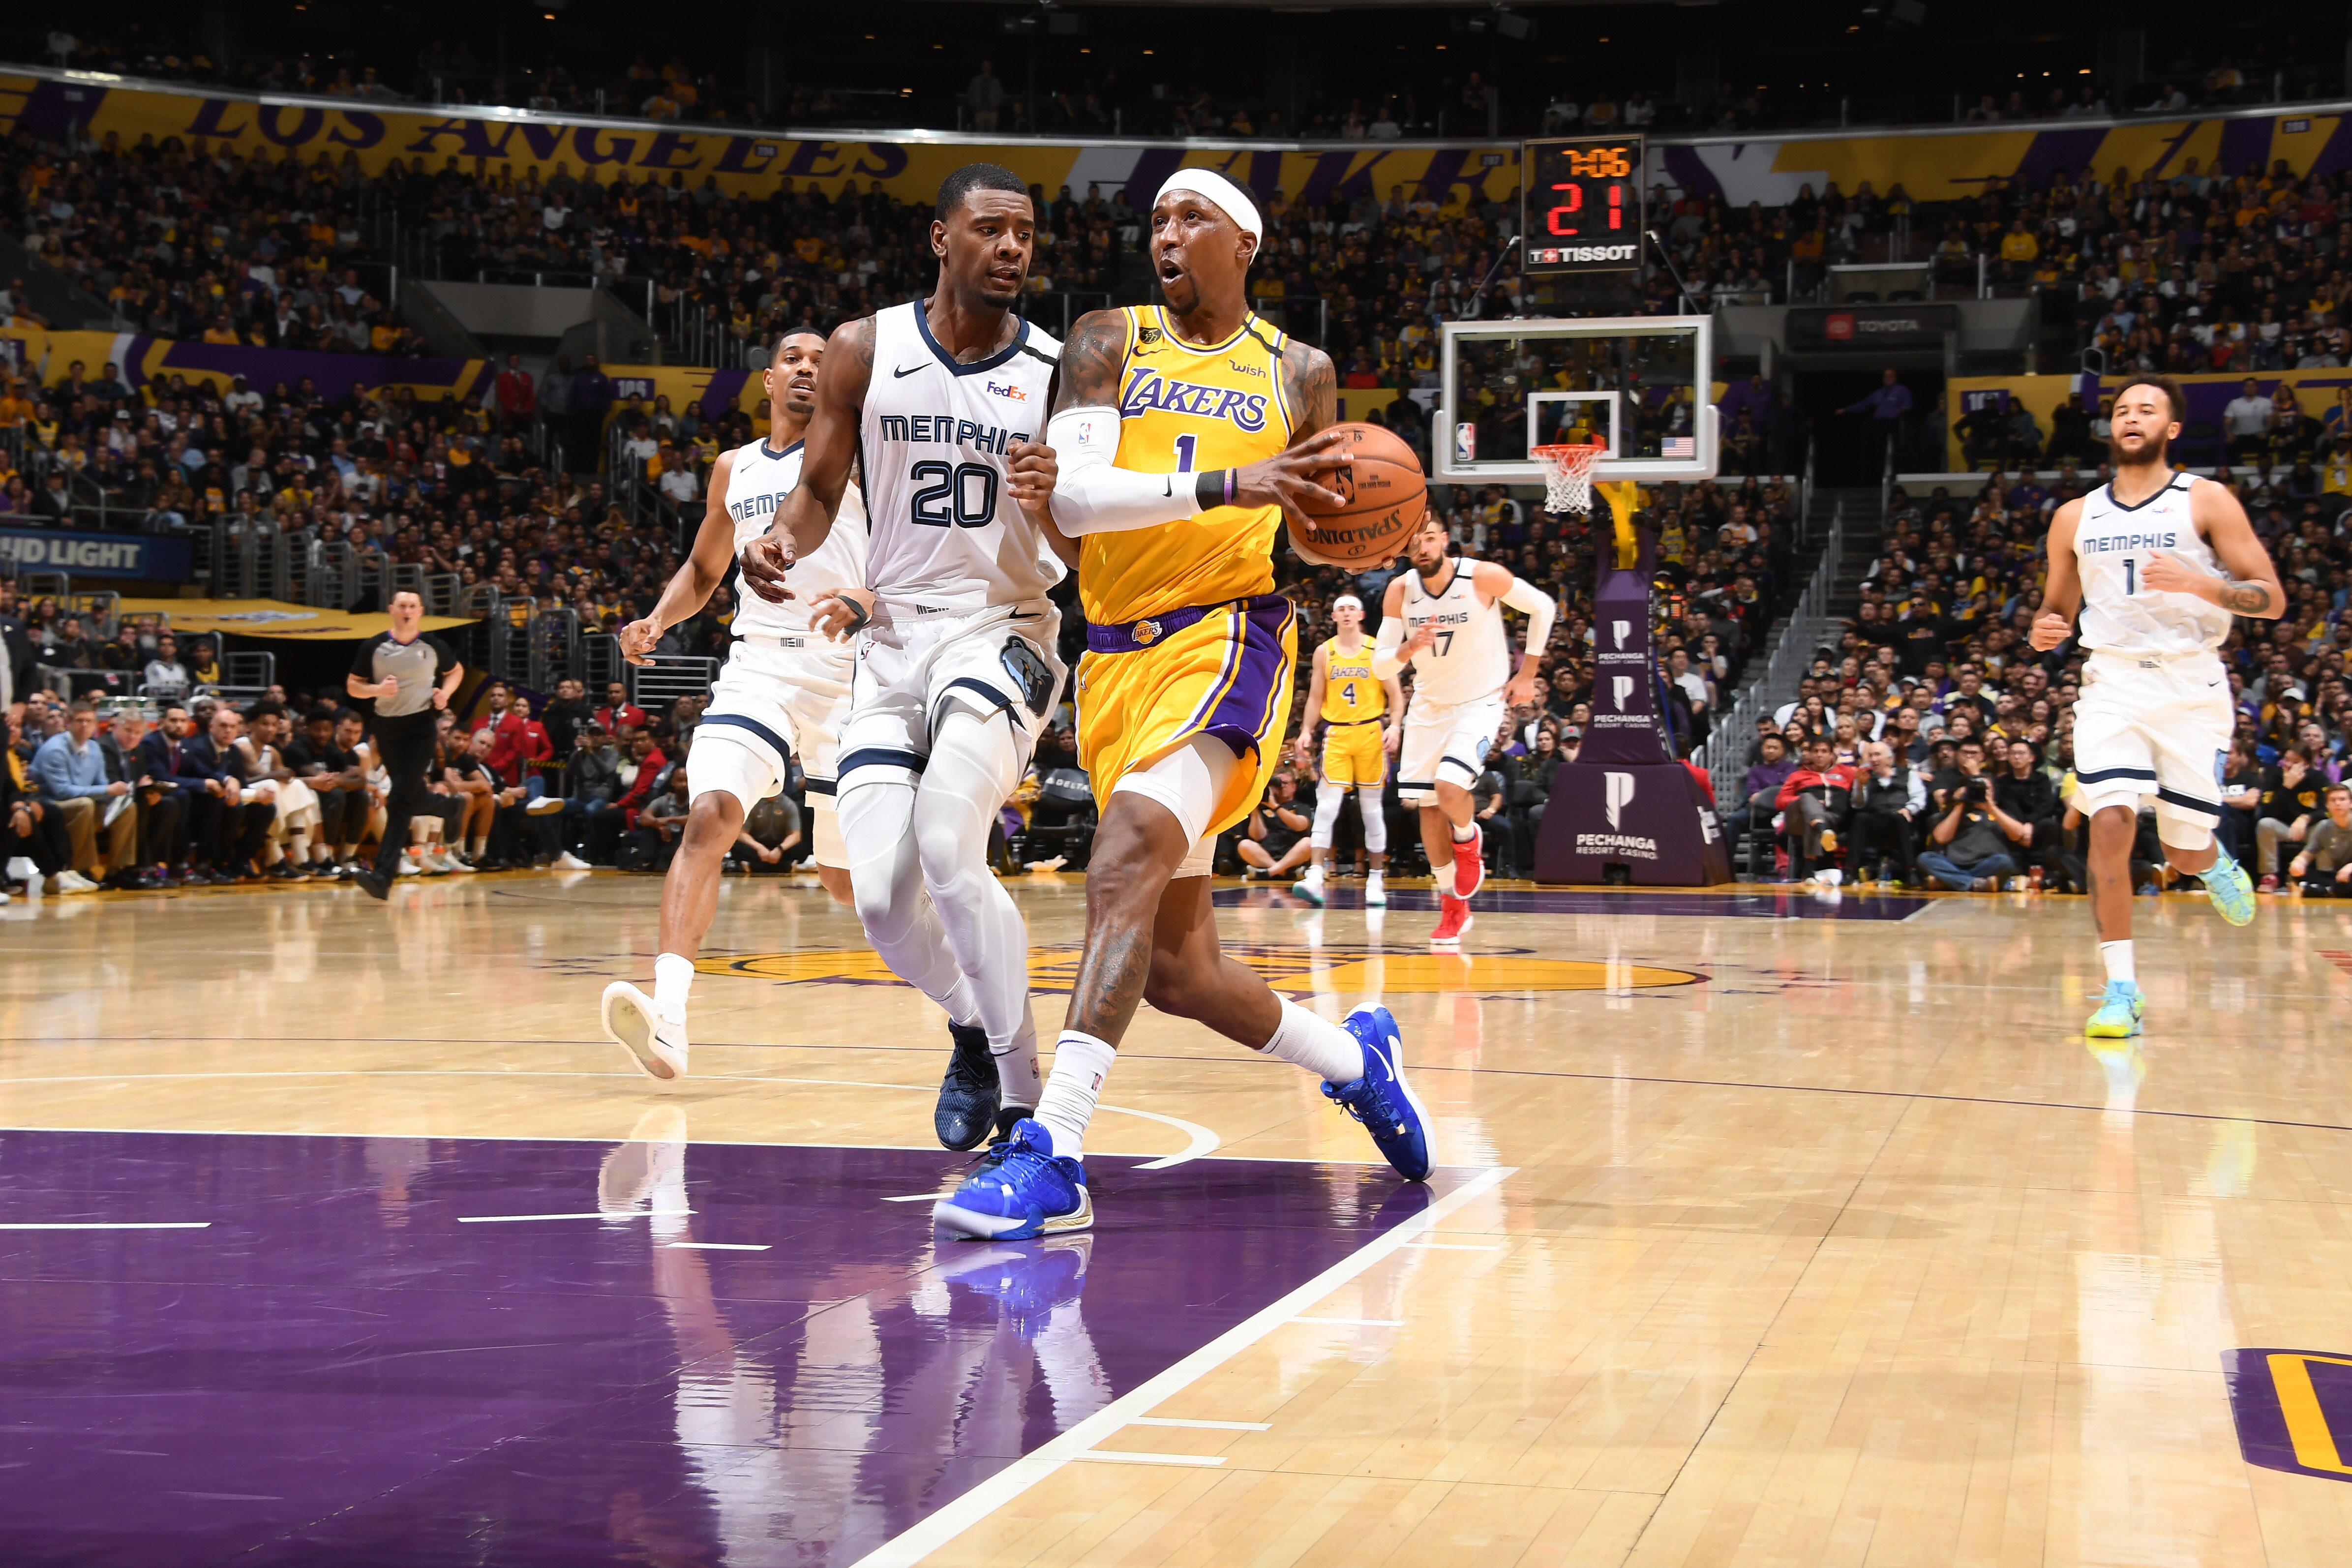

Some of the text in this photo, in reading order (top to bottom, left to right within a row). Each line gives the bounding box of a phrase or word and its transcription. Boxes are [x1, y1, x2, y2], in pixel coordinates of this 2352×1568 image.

[184, 98, 910, 180] LOS ANGELES
[1561, 147, 1630, 178] 7:06
[1547, 183, 1622, 236] 21
[1558, 244, 1638, 262] TISSOT
[1857, 320, 1919, 332] TOYOTA
[1229, 359, 1266, 379] wish
[987, 381, 1027, 401] FedEx
[1121, 367, 1269, 433] LAKERS
[1174, 433, 1198, 473] 1
[910, 460, 999, 529] 20
[731, 492, 787, 524] MEMP
[1306, 509, 1403, 545] SPALDING
[0, 537, 142, 570] UD LIGHT
[2083, 532, 2176, 555] MEMPHIS
[2122, 559, 2135, 595] 1
[1408, 611, 1468, 628] MEPHIS
[1133, 626, 1161, 640] LAKERS
[1329, 665, 1369, 680] LAKERS
[1341, 682, 1356, 706] 4
[1056, 779, 1089, 792] DELTA
[1575, 846, 1616, 855] RESORT
[1576, 834, 1657, 851] PECHANGA
